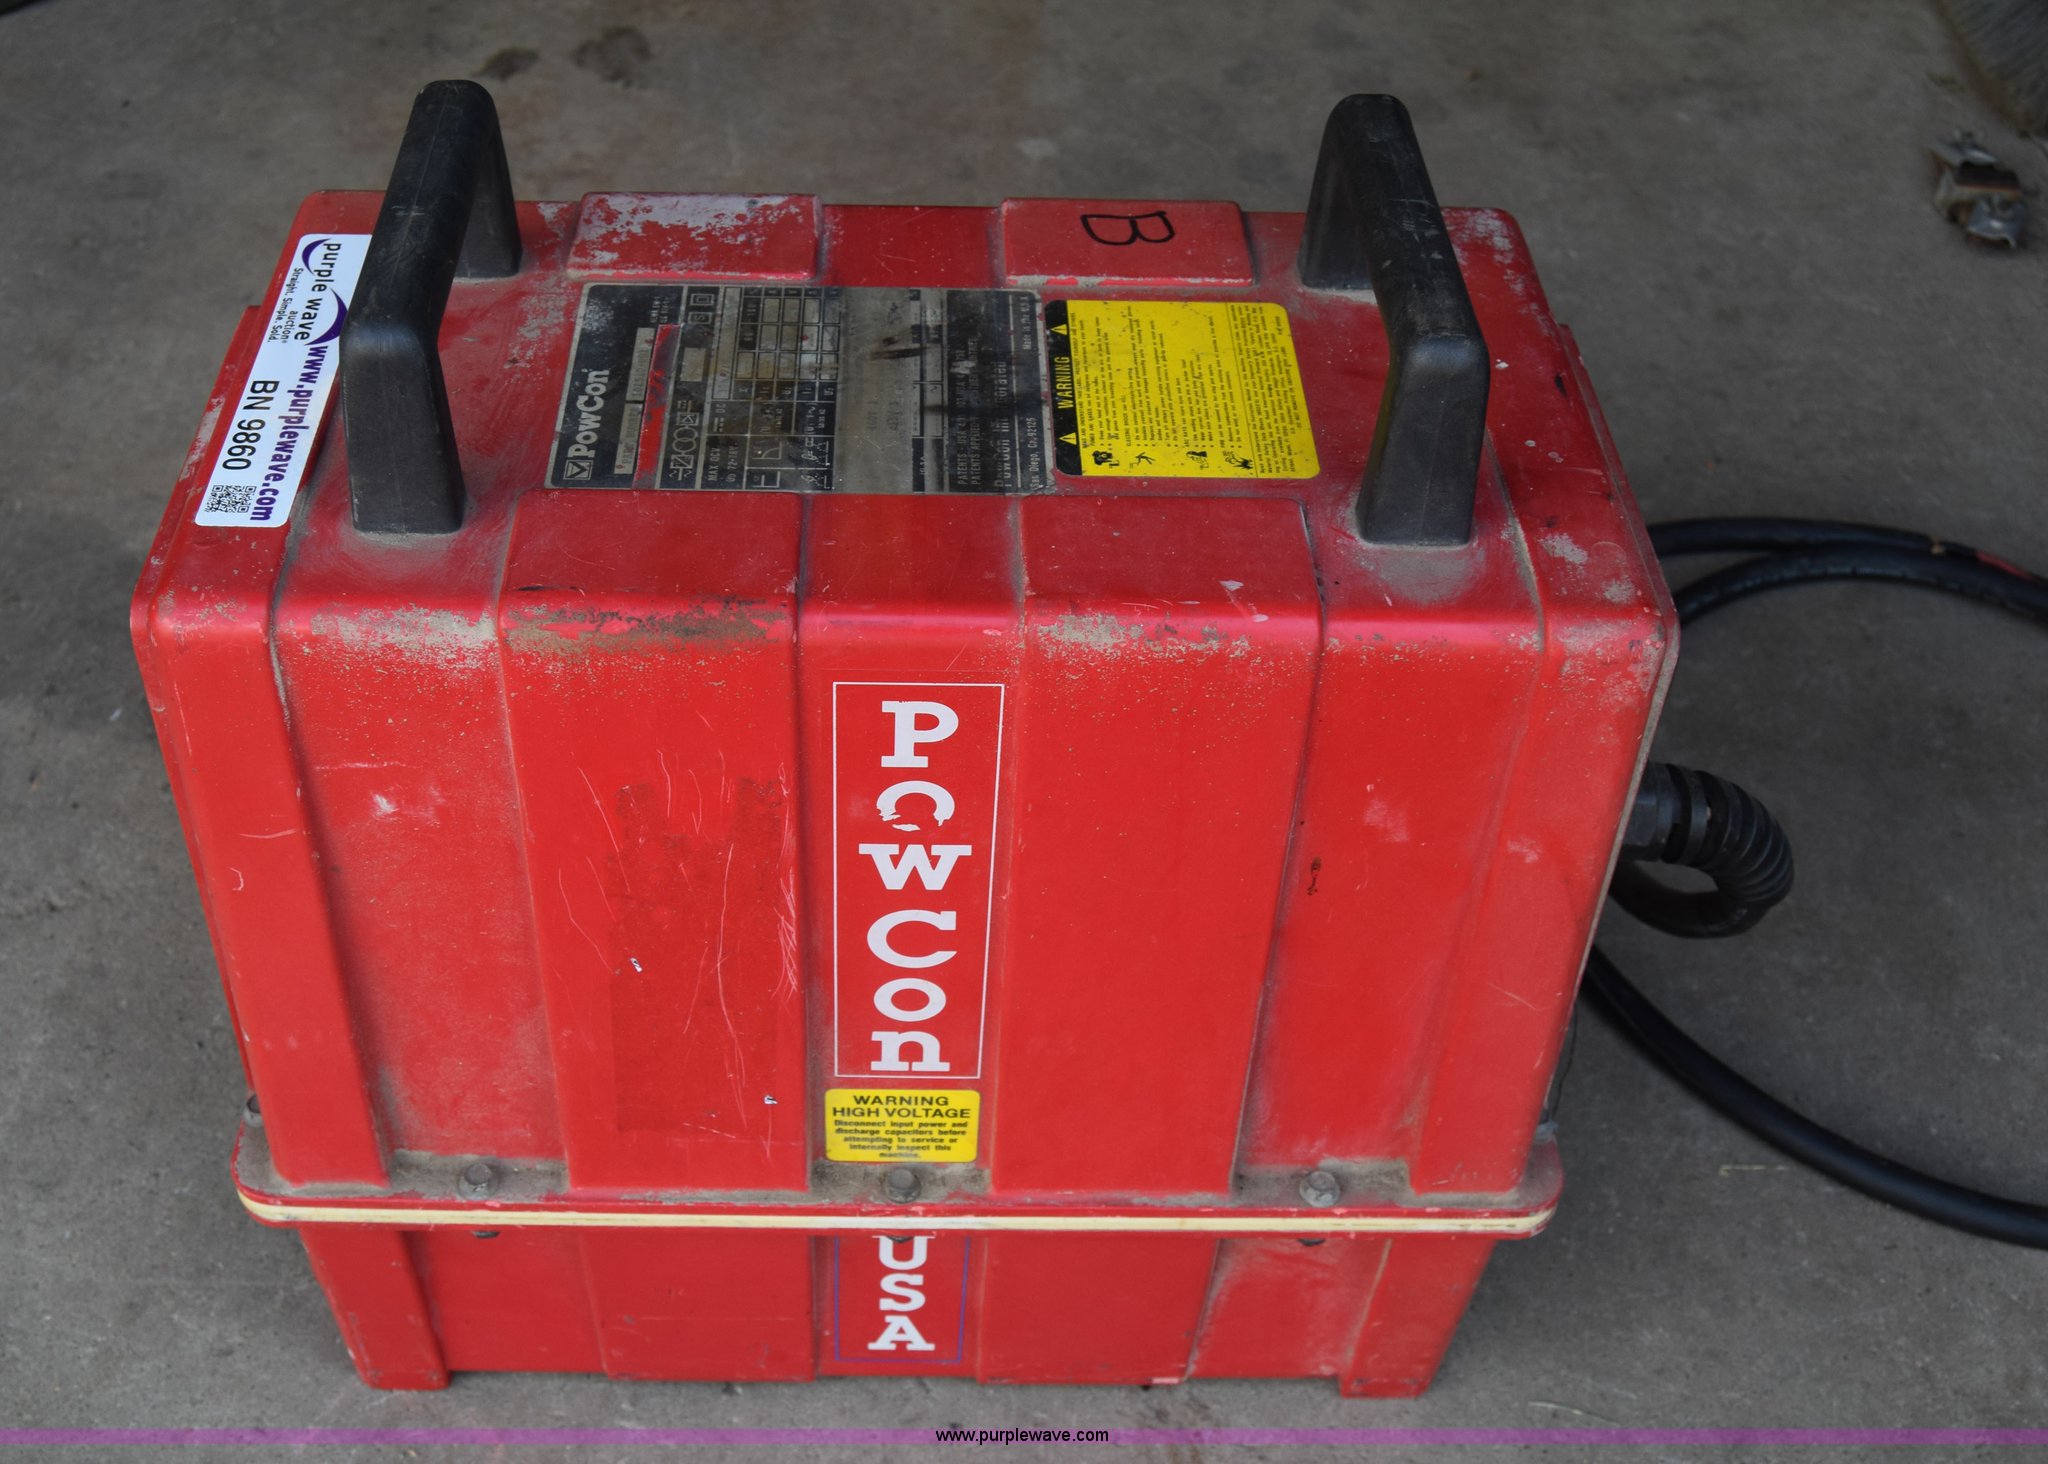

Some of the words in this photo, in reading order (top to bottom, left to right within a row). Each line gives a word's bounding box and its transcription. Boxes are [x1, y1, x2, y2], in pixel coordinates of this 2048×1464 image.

[1080, 210, 1175, 246] B
[285, 268, 304, 296] Straight.
[311, 243, 342, 292] purple
[275, 297, 293, 325] Simple.
[294, 297, 323, 341] wave
[267, 325, 283, 343] Sold.
[243, 380, 280, 411] BN
[1053, 355, 1074, 408] WARNING
[567, 368, 610, 458] PowCon
[222, 419, 266, 471] 9860
[250, 345, 328, 521] www.purplewave.com
[708, 446, 721, 462] OCV
[706, 464, 720, 481] MAX
[858, 700, 972, 1072] PowCon
[832, 1107, 880, 1118] HIGH
[885, 1107, 971, 1119] VOLTAGE
[852, 1095, 950, 1106] WARNING
[834, 1119, 886, 1128] Disconnect
[890, 1120, 914, 1129] input
[918, 1121, 947, 1129] power
[835, 1128, 880, 1136] discharge
[885, 1128, 933, 1136] capacitors
[843, 1136, 893, 1144] attempting
[867, 1236, 935, 1351] USA
